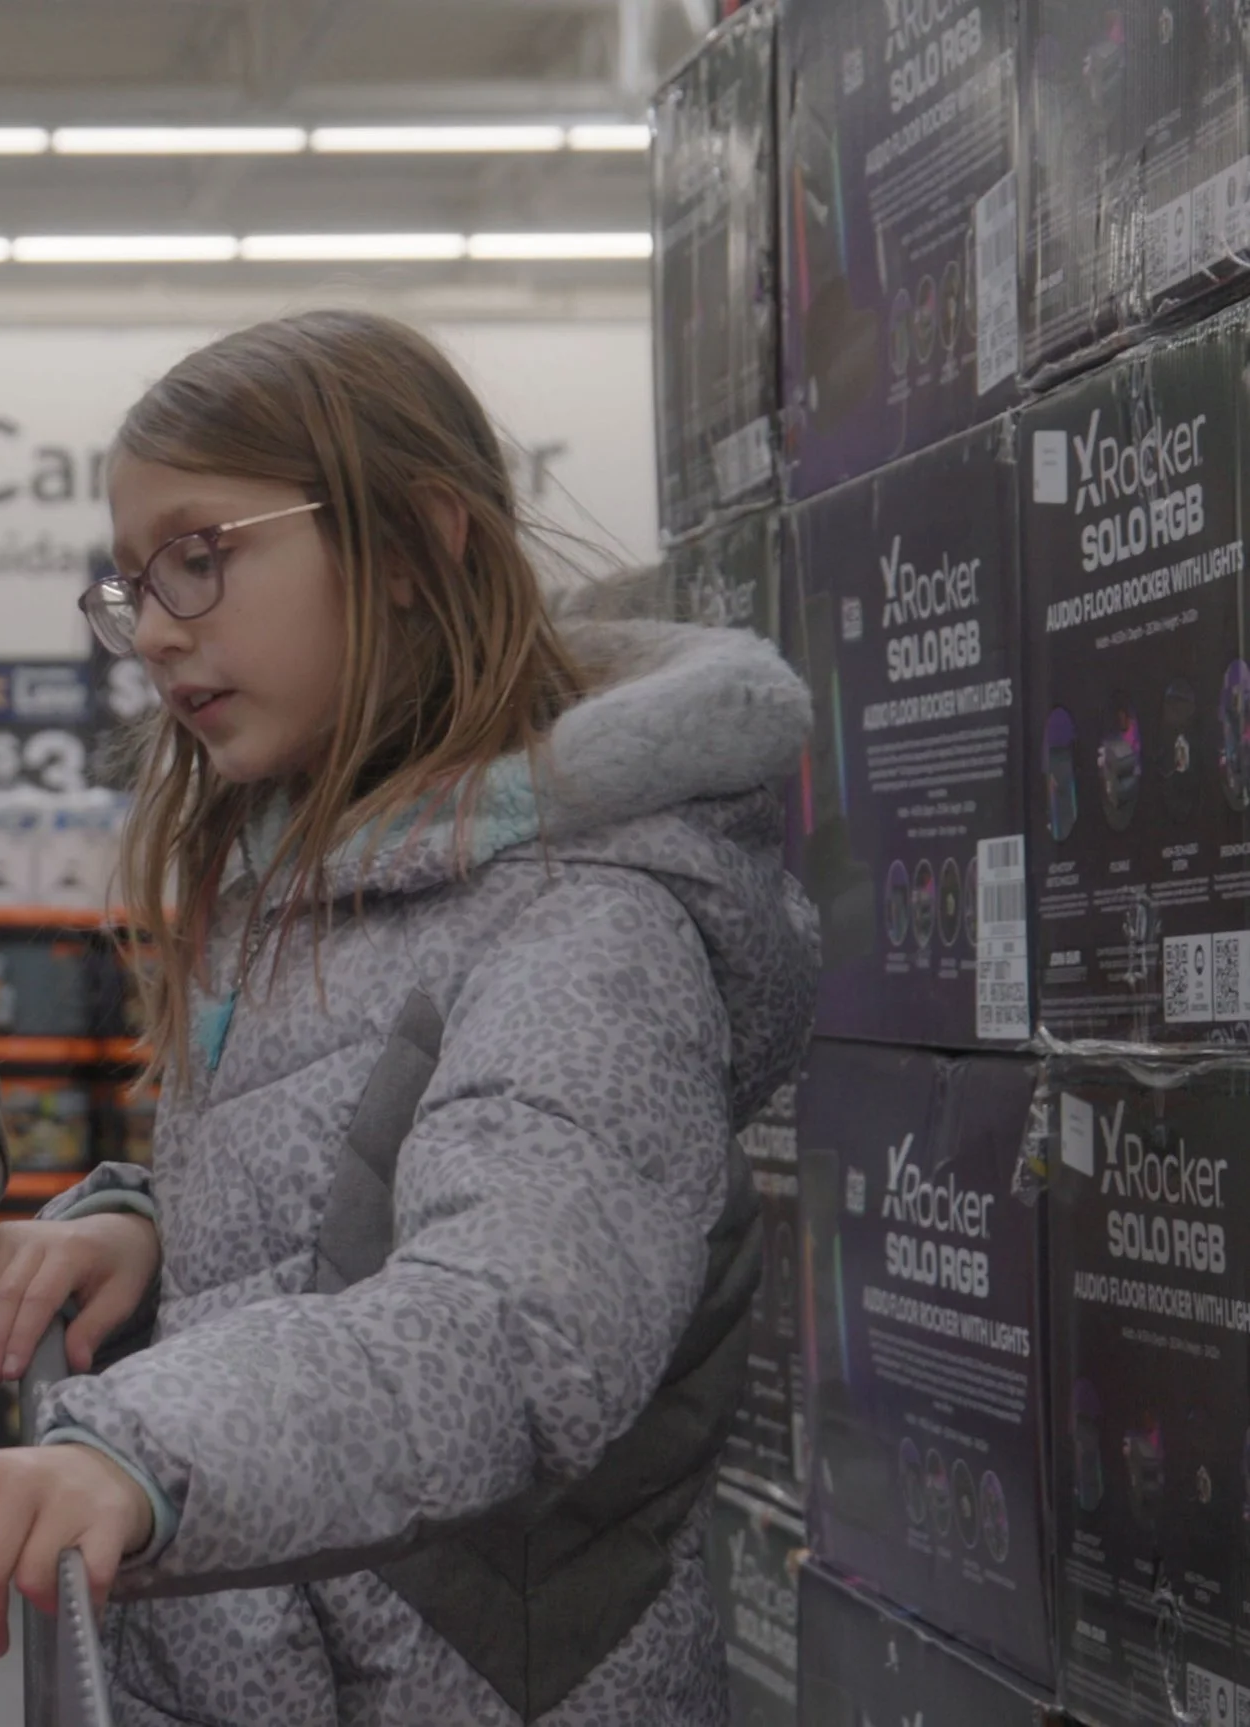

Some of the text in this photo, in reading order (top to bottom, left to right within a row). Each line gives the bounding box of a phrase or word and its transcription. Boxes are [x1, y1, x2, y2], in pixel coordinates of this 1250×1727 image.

[890, 41, 940, 113] SOLO
[941, 6, 981, 77] RGB
[1081, 483, 1204, 573] SOLO RGB
[1046, 597, 1083, 633] AUDIO
[1084, 584, 1122, 622] FLOOR
[1123, 567, 1171, 610] ROCKER
[1171, 555, 1202, 593] WITH
[1203, 539, 1244, 583] LIGHTS
[887, 619, 981, 682] SOLO RGB
[886, 1231, 989, 1298] SOLO RGB
[1107, 1210, 1226, 1275] SOLO RGB
[1073, 1270, 1250, 1334] AUDIO FLOOR ROCKER WITH LIGH
[990, 1320, 1031, 1357] LIGHTS
